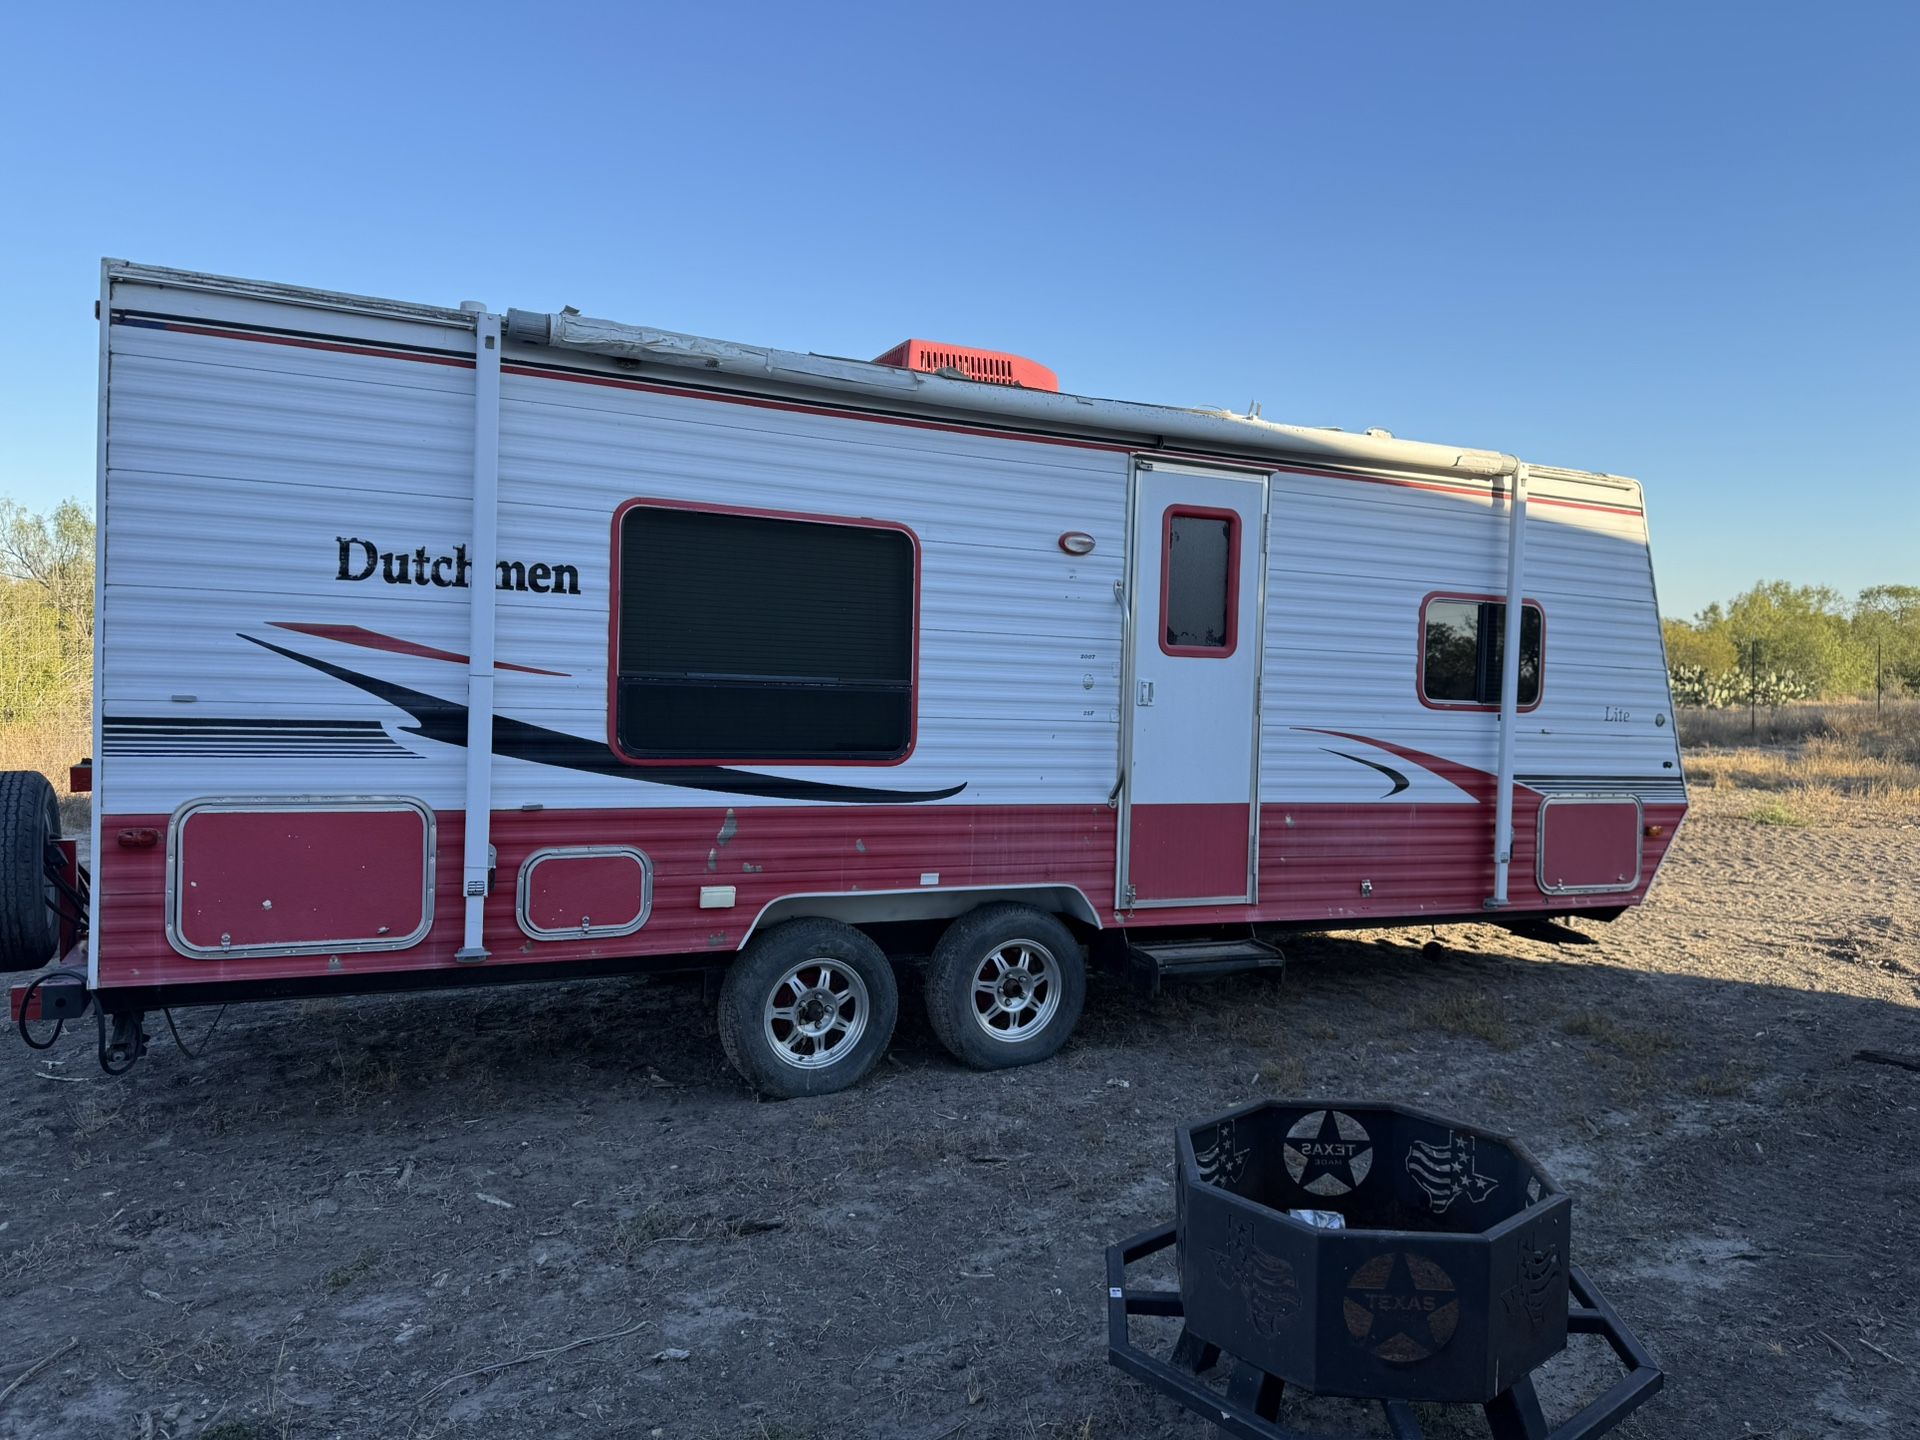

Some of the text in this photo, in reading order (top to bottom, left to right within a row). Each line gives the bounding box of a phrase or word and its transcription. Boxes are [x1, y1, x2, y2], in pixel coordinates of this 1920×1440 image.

[334, 536, 581, 595] Dutchmen
[1603, 706, 1630, 722] Lite
[1364, 1293, 1436, 1311] TEXAS
